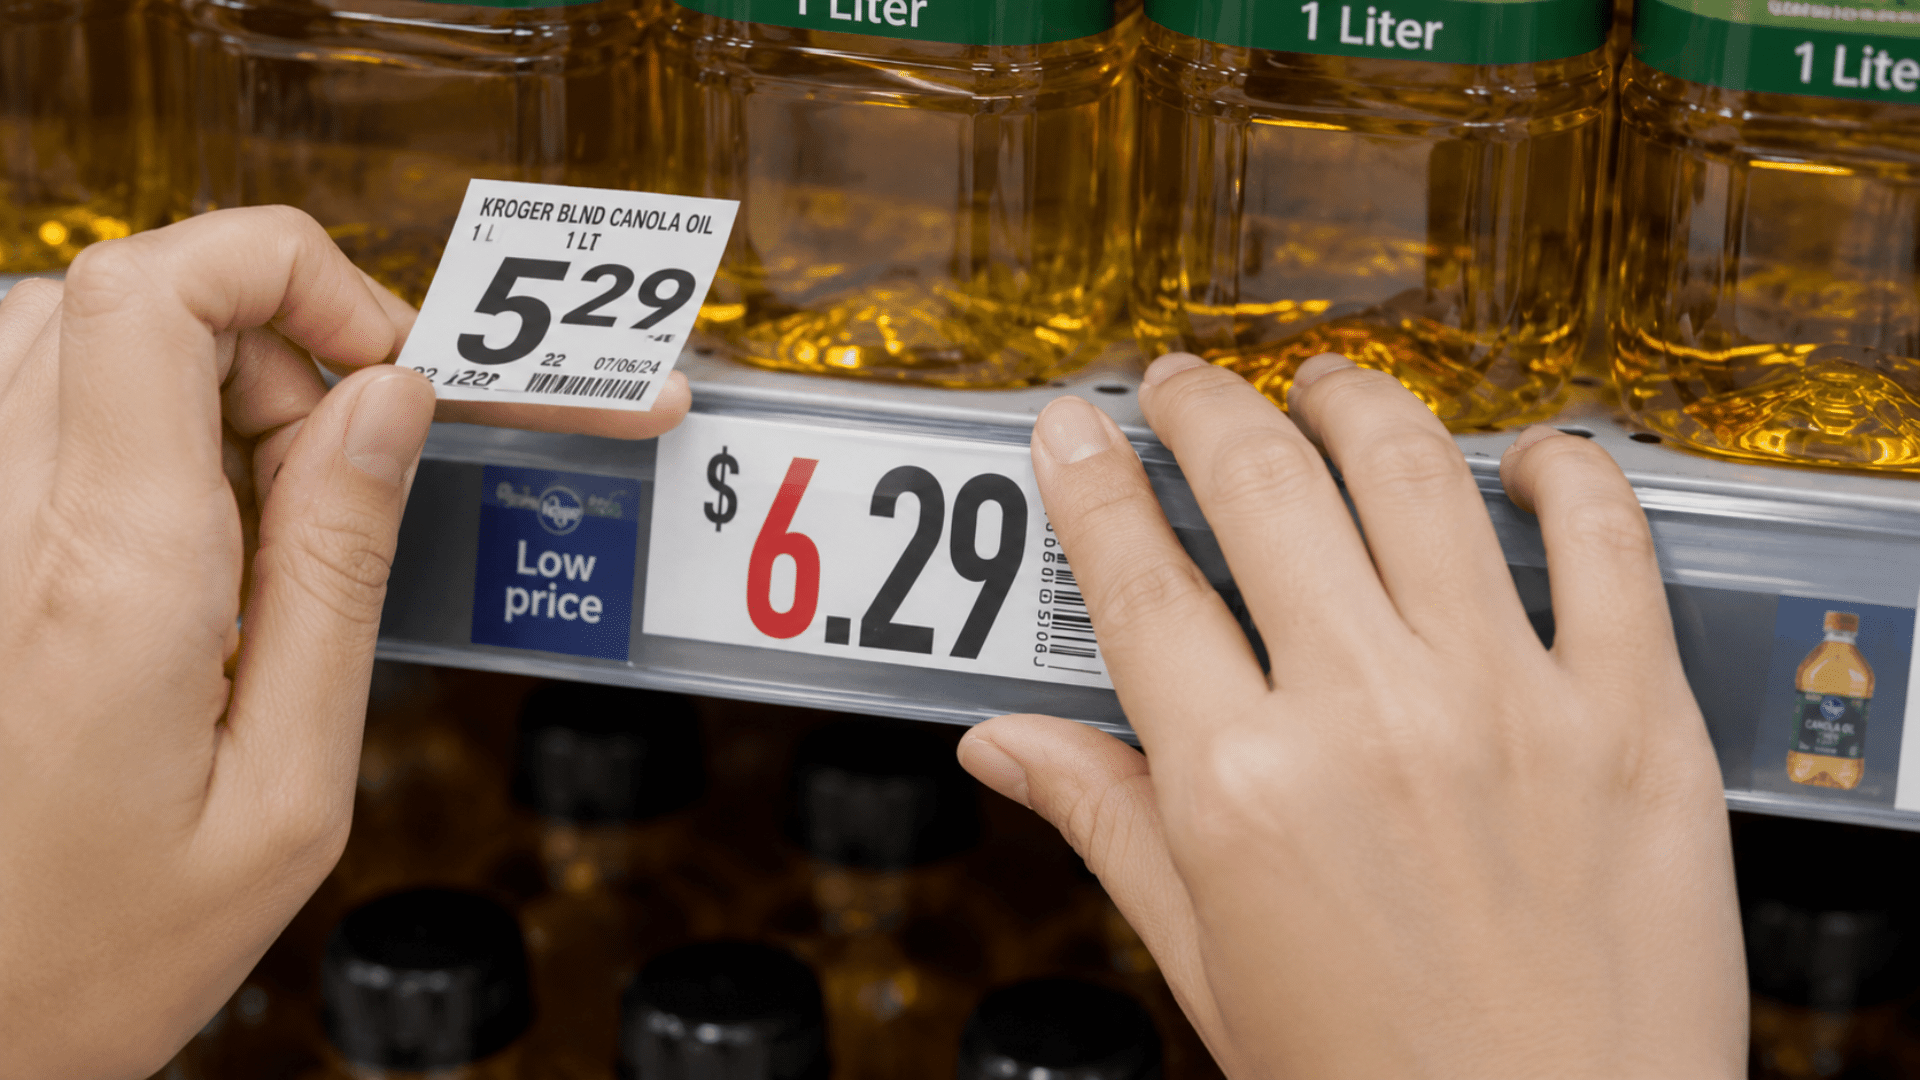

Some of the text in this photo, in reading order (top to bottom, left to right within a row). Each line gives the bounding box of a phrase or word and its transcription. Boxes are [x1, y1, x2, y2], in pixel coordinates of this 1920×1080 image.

[1301, 1, 1443, 50] 1 Liter
[1794, 41, 1814, 83] 1
[472, 223, 482, 242] 1
[480, 197, 714, 234] KROGER BLND CANOLA OIL
[565, 231, 602, 251] 1 LT
[539, 352, 662, 375] 22 07/06/24
[517, 540, 597, 583] Low
[504, 581, 603, 624] price
